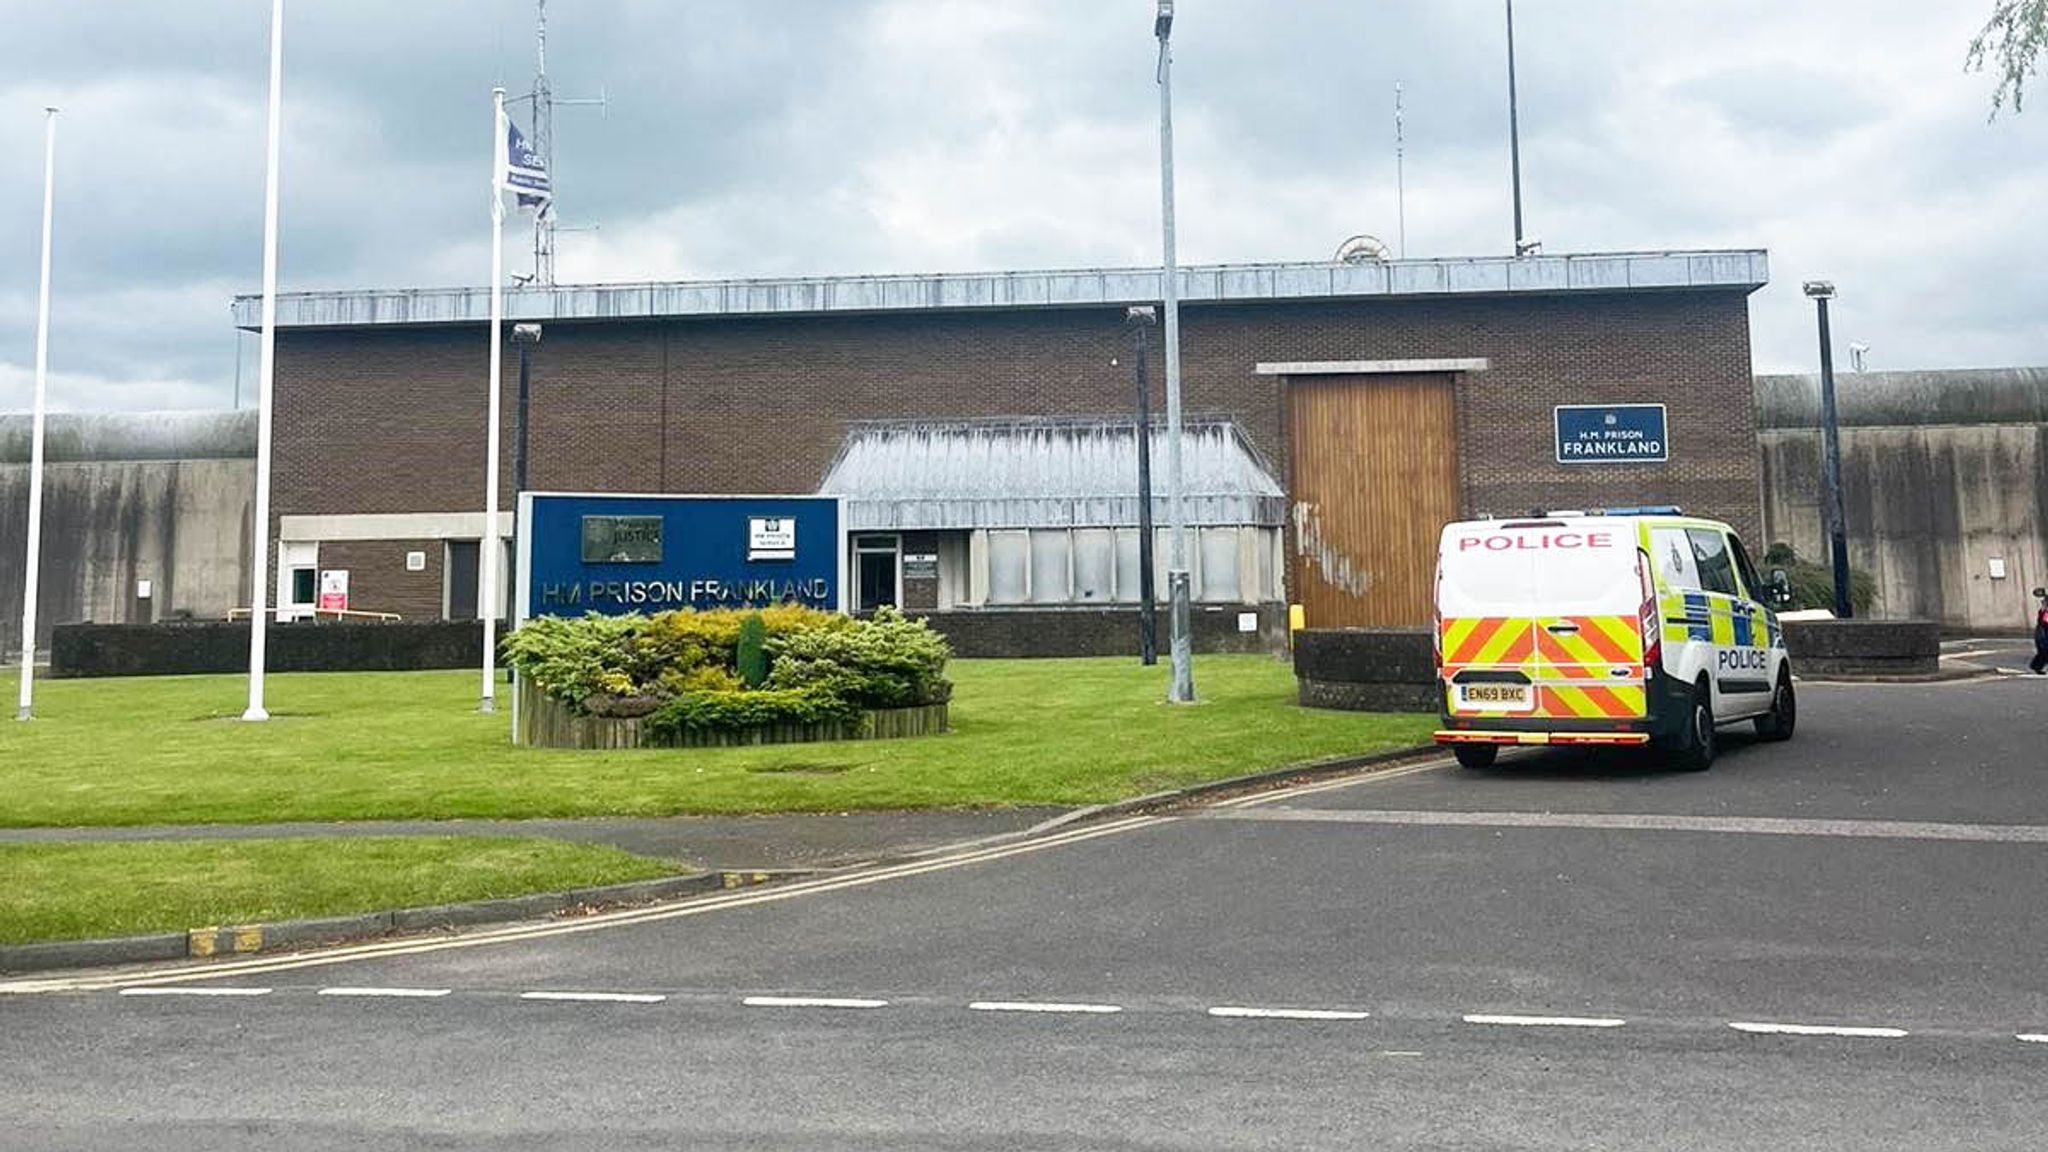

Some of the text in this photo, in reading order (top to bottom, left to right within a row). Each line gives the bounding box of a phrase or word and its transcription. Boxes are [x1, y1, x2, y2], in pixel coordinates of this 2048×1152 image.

[1604, 430, 1643, 439] PRISON
[1564, 441, 1660, 455] FRANKLAND
[1459, 533, 1612, 551] POLICE
[590, 581, 683, 603] PRISON
[691, 579, 829, 601] FRANKLAND
[1719, 650, 1766, 670] POLICE
[1469, 688, 1498, 700] EN69
